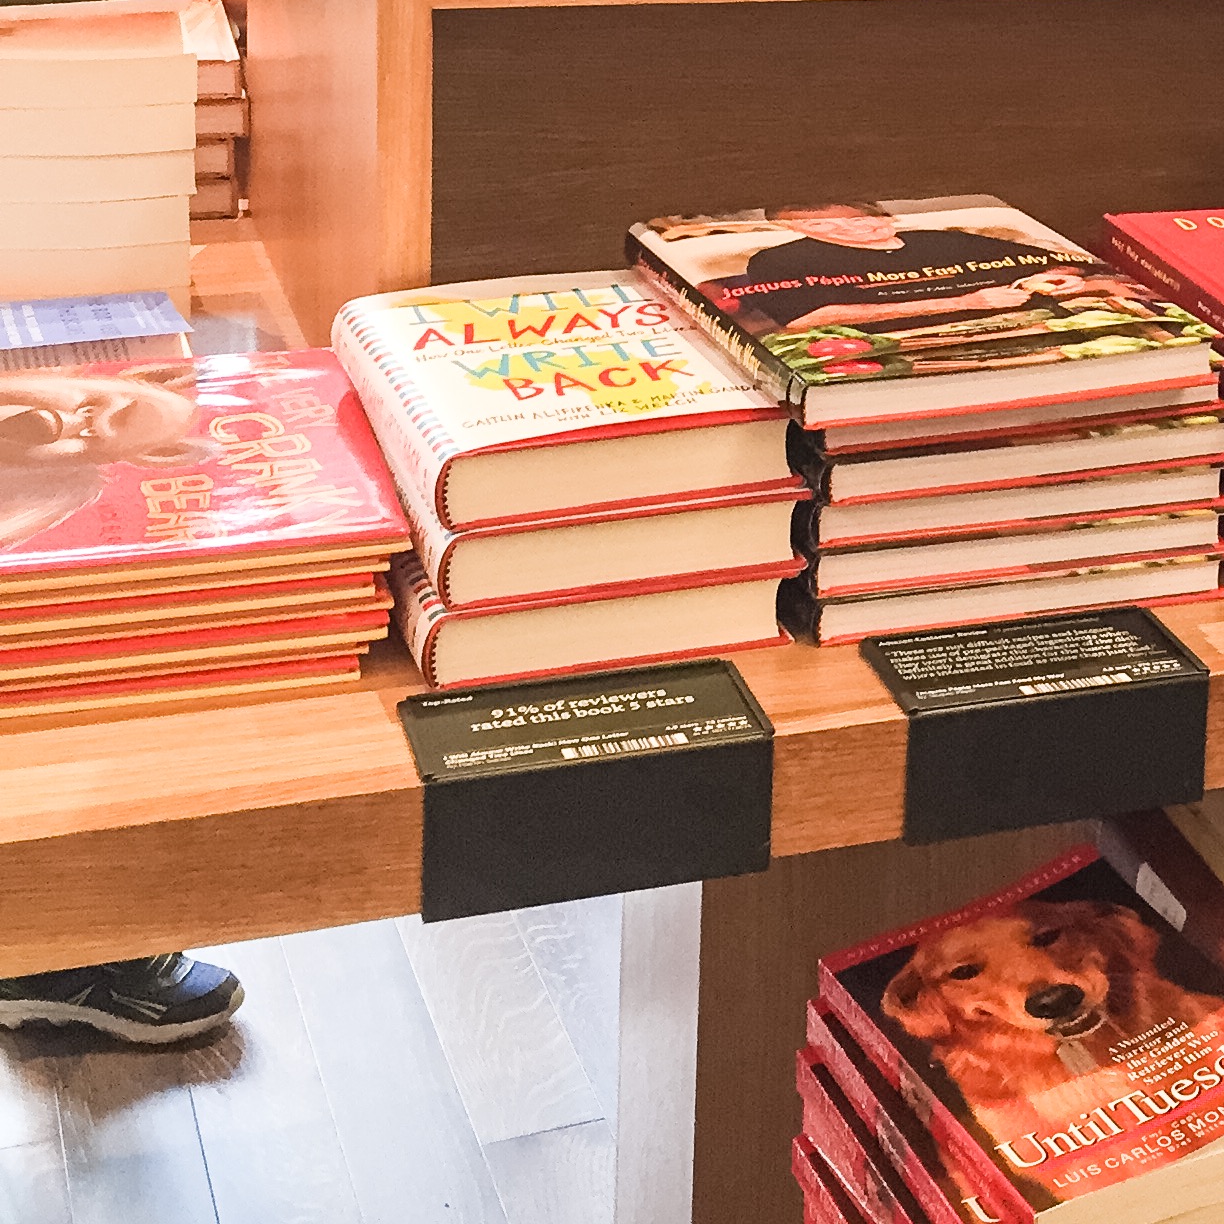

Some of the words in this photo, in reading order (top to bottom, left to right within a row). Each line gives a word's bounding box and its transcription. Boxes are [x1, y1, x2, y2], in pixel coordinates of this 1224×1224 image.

[722, 278, 803, 299] Jacques
[806, 274, 862, 287] Pépin
[867, 270, 919, 284] More
[923, 264, 962, 277] Fast
[966, 256, 1015, 271] Food
[1018, 254, 1048, 269] My
[1049, 252, 1094, 264] Way
[410, 305, 452, 326] I
[465, 284, 654, 317] WILL
[413, 303, 670, 350] ALWAYS
[454, 349, 482, 357] One
[615, 328, 644, 338] Two
[451, 337, 682, 379] WRITE
[503, 360, 694, 401] BACK
[462, 413, 525, 429] CAITLIN
[651, 387, 704, 403] MARTIN
[638, 398, 698, 412] WELCH
[471, 717, 527, 732] rated
[530, 712, 570, 726] this
[573, 705, 627, 719] book
[630, 701, 640, 711] 5
[646, 694, 695, 710] stars
[491, 703, 539, 718] 91%
[542, 701, 566, 712] of
[569, 688, 666, 710] reviewers
[1109, 1047, 1118, 1055] A
[1117, 1017, 1175, 1048] Wounded
[1112, 1037, 1161, 1063] Warrior
[1165, 1022, 1188, 1038] and
[1127, 1057, 1147, 1070] the
[1150, 1032, 1194, 1058] Golden
[1127, 1048, 1186, 1081] Retriever
[1187, 1030, 1219, 1048] Who
[1143, 1062, 1183, 1085] Saved
[1183, 1046, 1212, 1064] Him
[994, 1106, 1124, 1168] Until
[1052, 1165, 1101, 1188] LUIS
[1104, 1128, 1186, 1168] CARLOS
